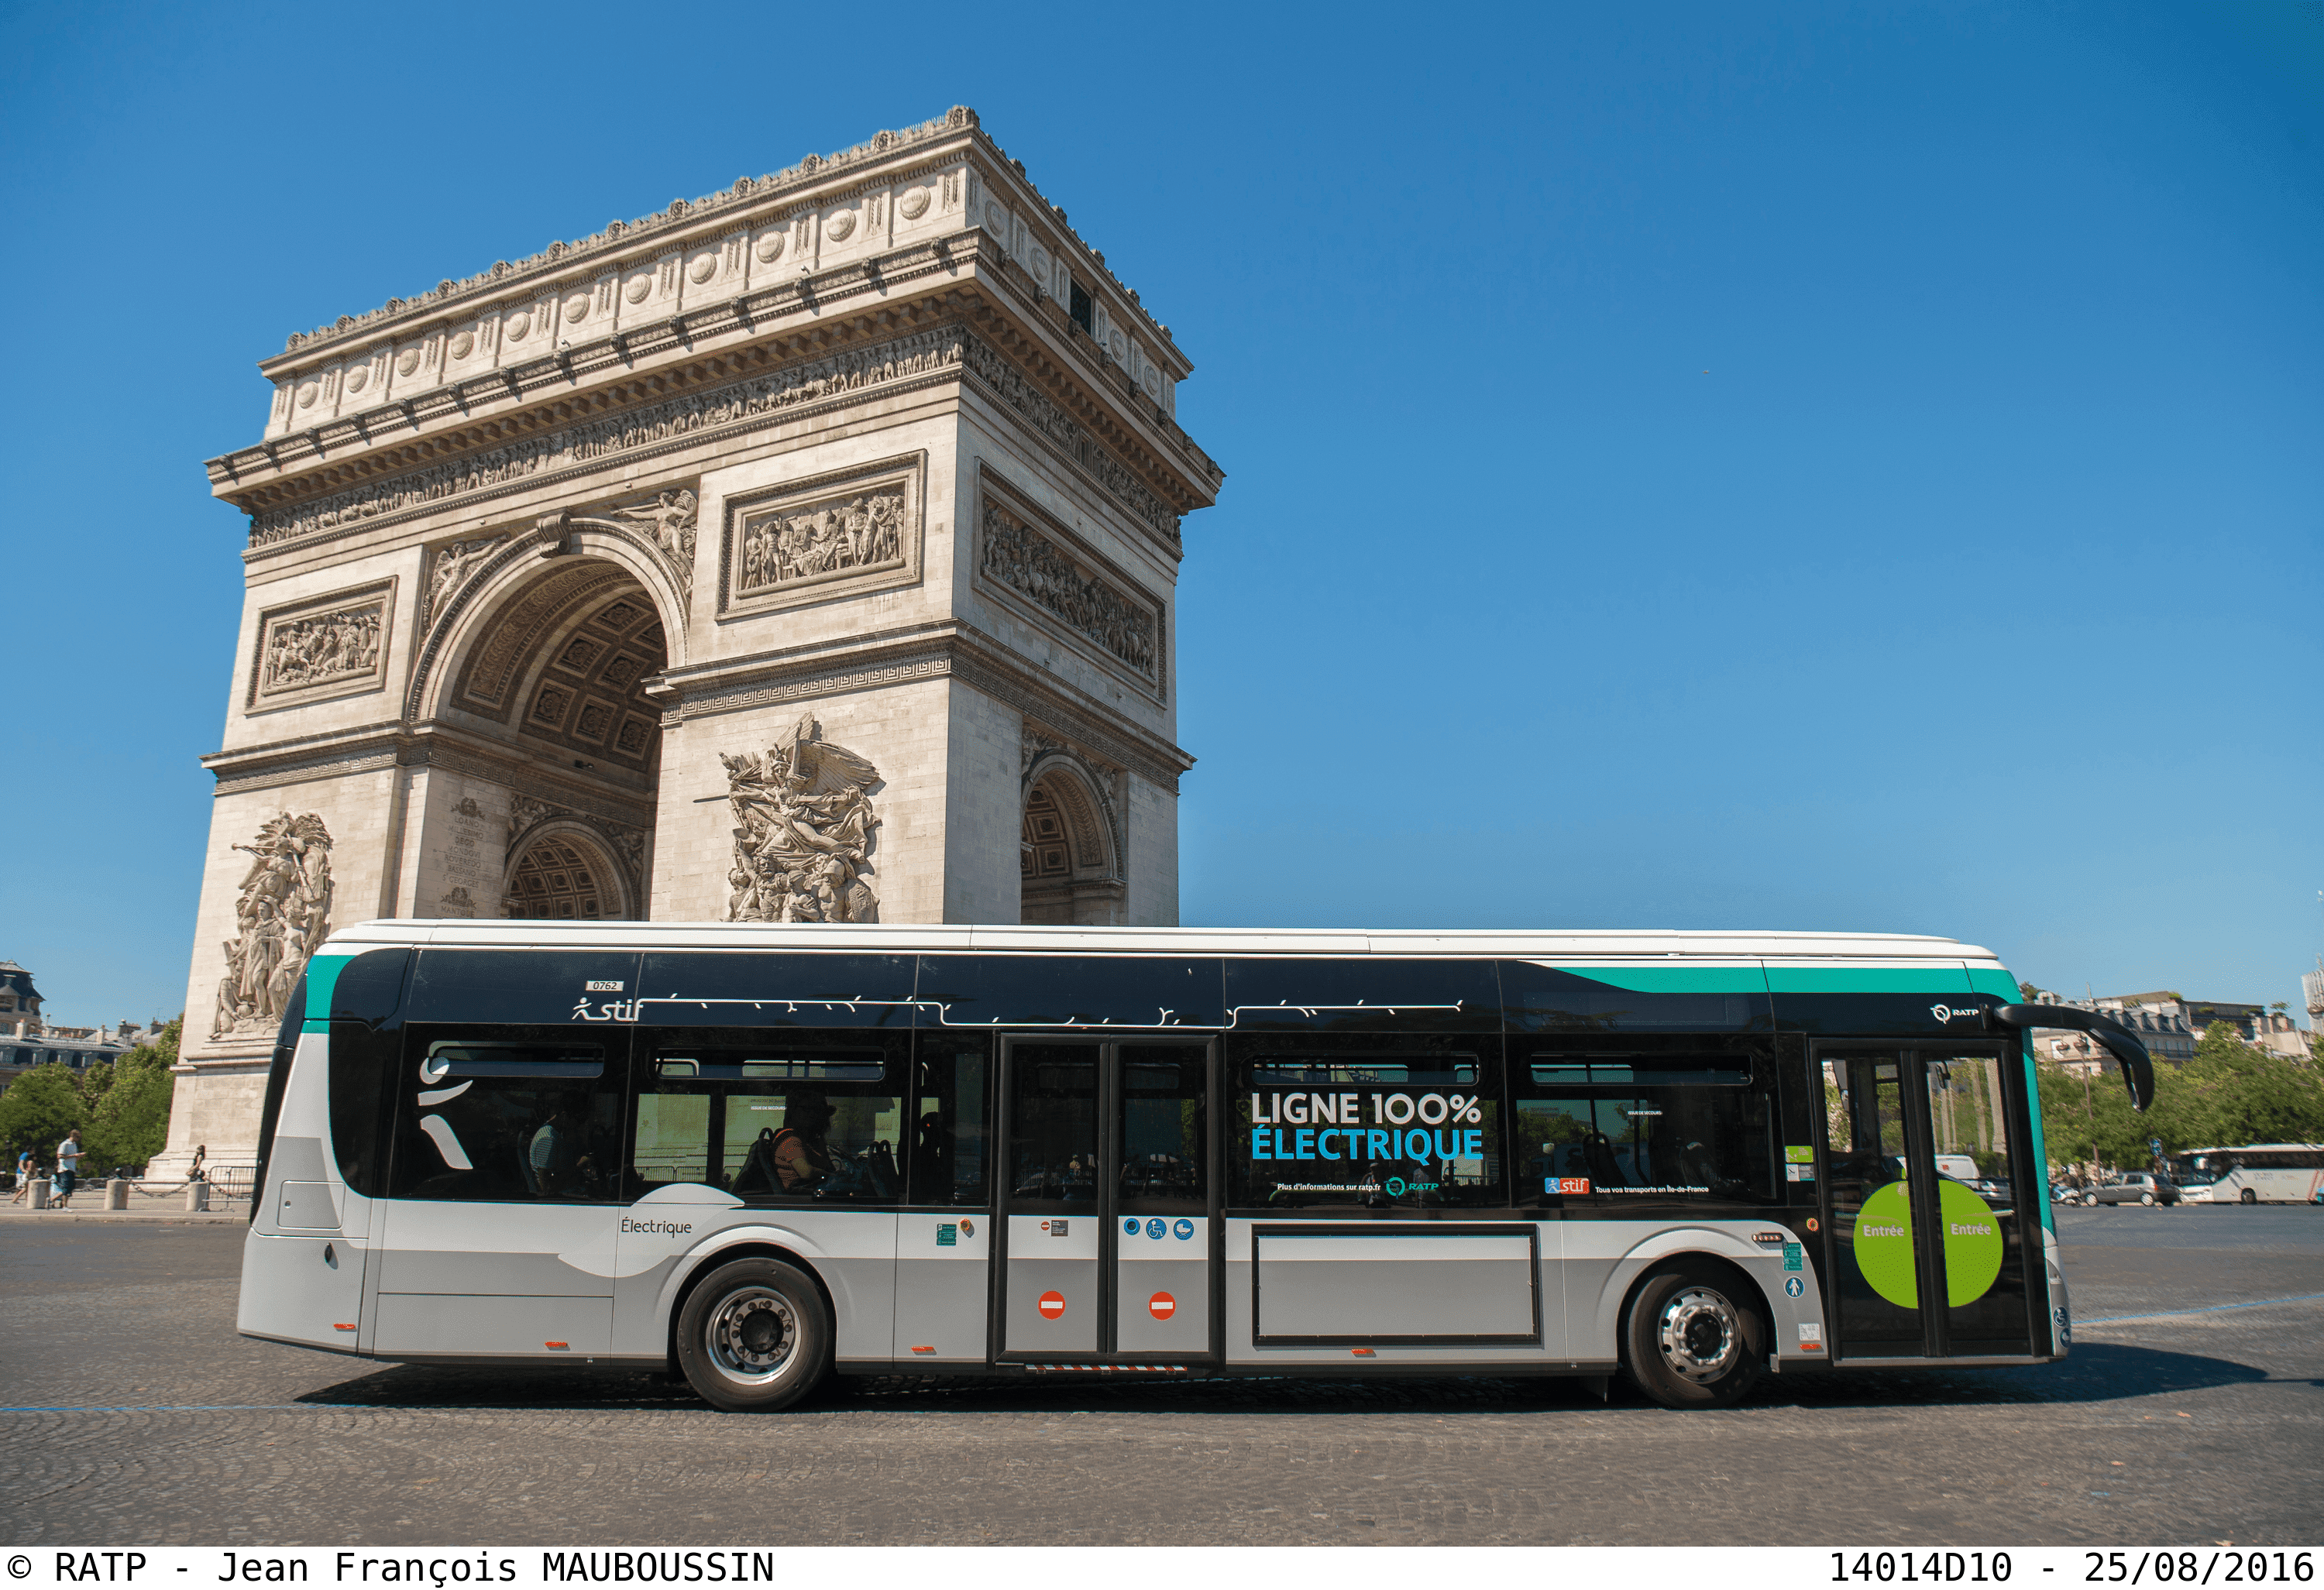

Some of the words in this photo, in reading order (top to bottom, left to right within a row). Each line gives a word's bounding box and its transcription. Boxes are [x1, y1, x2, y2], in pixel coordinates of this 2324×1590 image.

[455, 816, 480, 828] LOANO
[449, 825, 484, 840] MILLESIMO
[455, 836, 475, 847] DEGO
[448, 845, 480, 859] MONDOVI
[445, 853, 481, 868] ROVEREDO
[448, 864, 476, 877] BASSANO
[449, 876, 480, 888] GEORGES
[593, 981, 617, 990] 0762
[601, 998, 644, 1022] stif
[1252, 1093, 1360, 1124] LIGNE
[1371, 1093, 1482, 1125] 100%
[1252, 1125, 1483, 1166] ÉLECTRIQUE
[1358, 1183, 1381, 1192] ratp.fr
[1563, 1178, 1589, 1193] stif
[621, 1216, 692, 1239] Électrique
[1862, 1224, 1905, 1237] Entrée
[1950, 1222, 1992, 1236] Entrée
